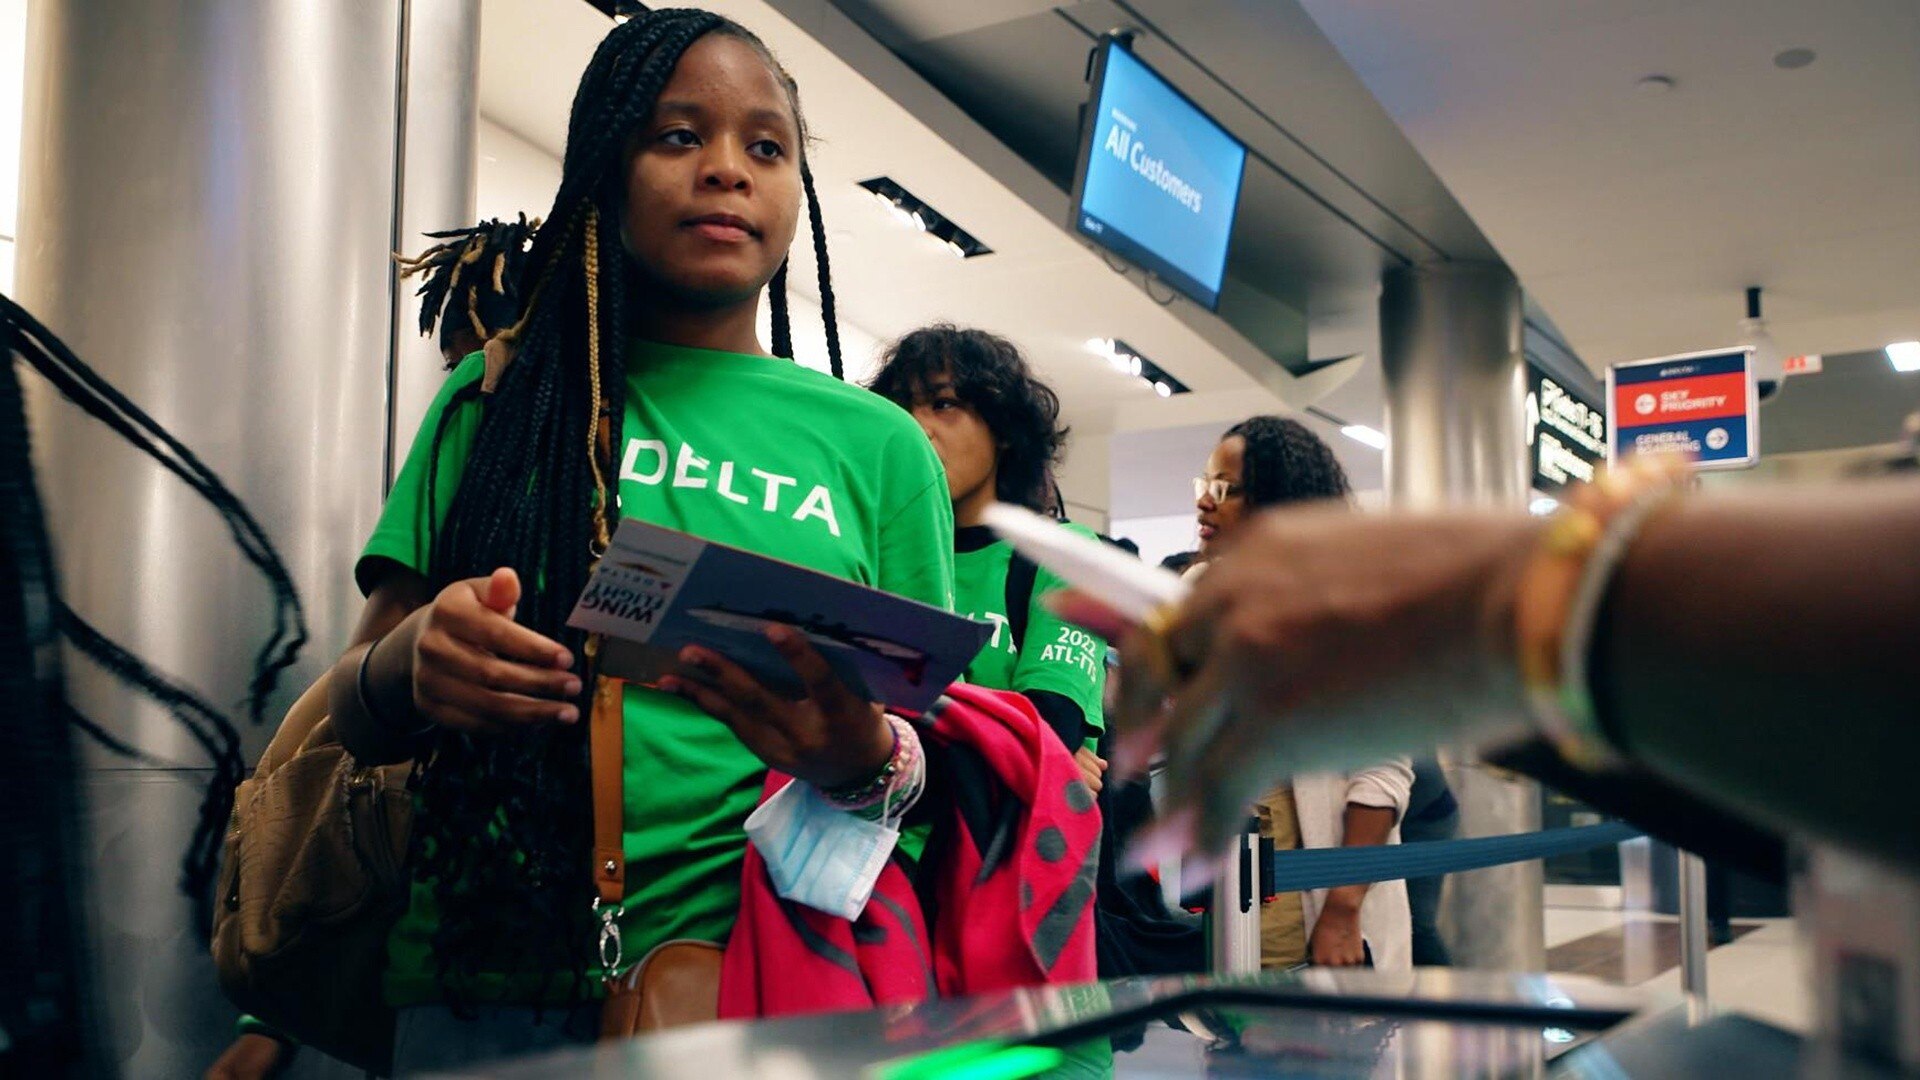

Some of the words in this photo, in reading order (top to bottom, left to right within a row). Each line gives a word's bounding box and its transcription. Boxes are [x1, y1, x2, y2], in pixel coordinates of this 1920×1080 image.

[1104, 124, 1131, 162] All
[1130, 141, 1204, 213] Customers
[1660, 389, 1690, 401] SKY
[1660, 396, 1726, 413] PRIORITY
[1635, 430, 1691, 445] GENERAL
[619, 438, 841, 538] DELTA
[581, 595, 652, 624] WING
[585, 583, 665, 611] FLIGHT
[1056, 626, 1096, 658] 2022
